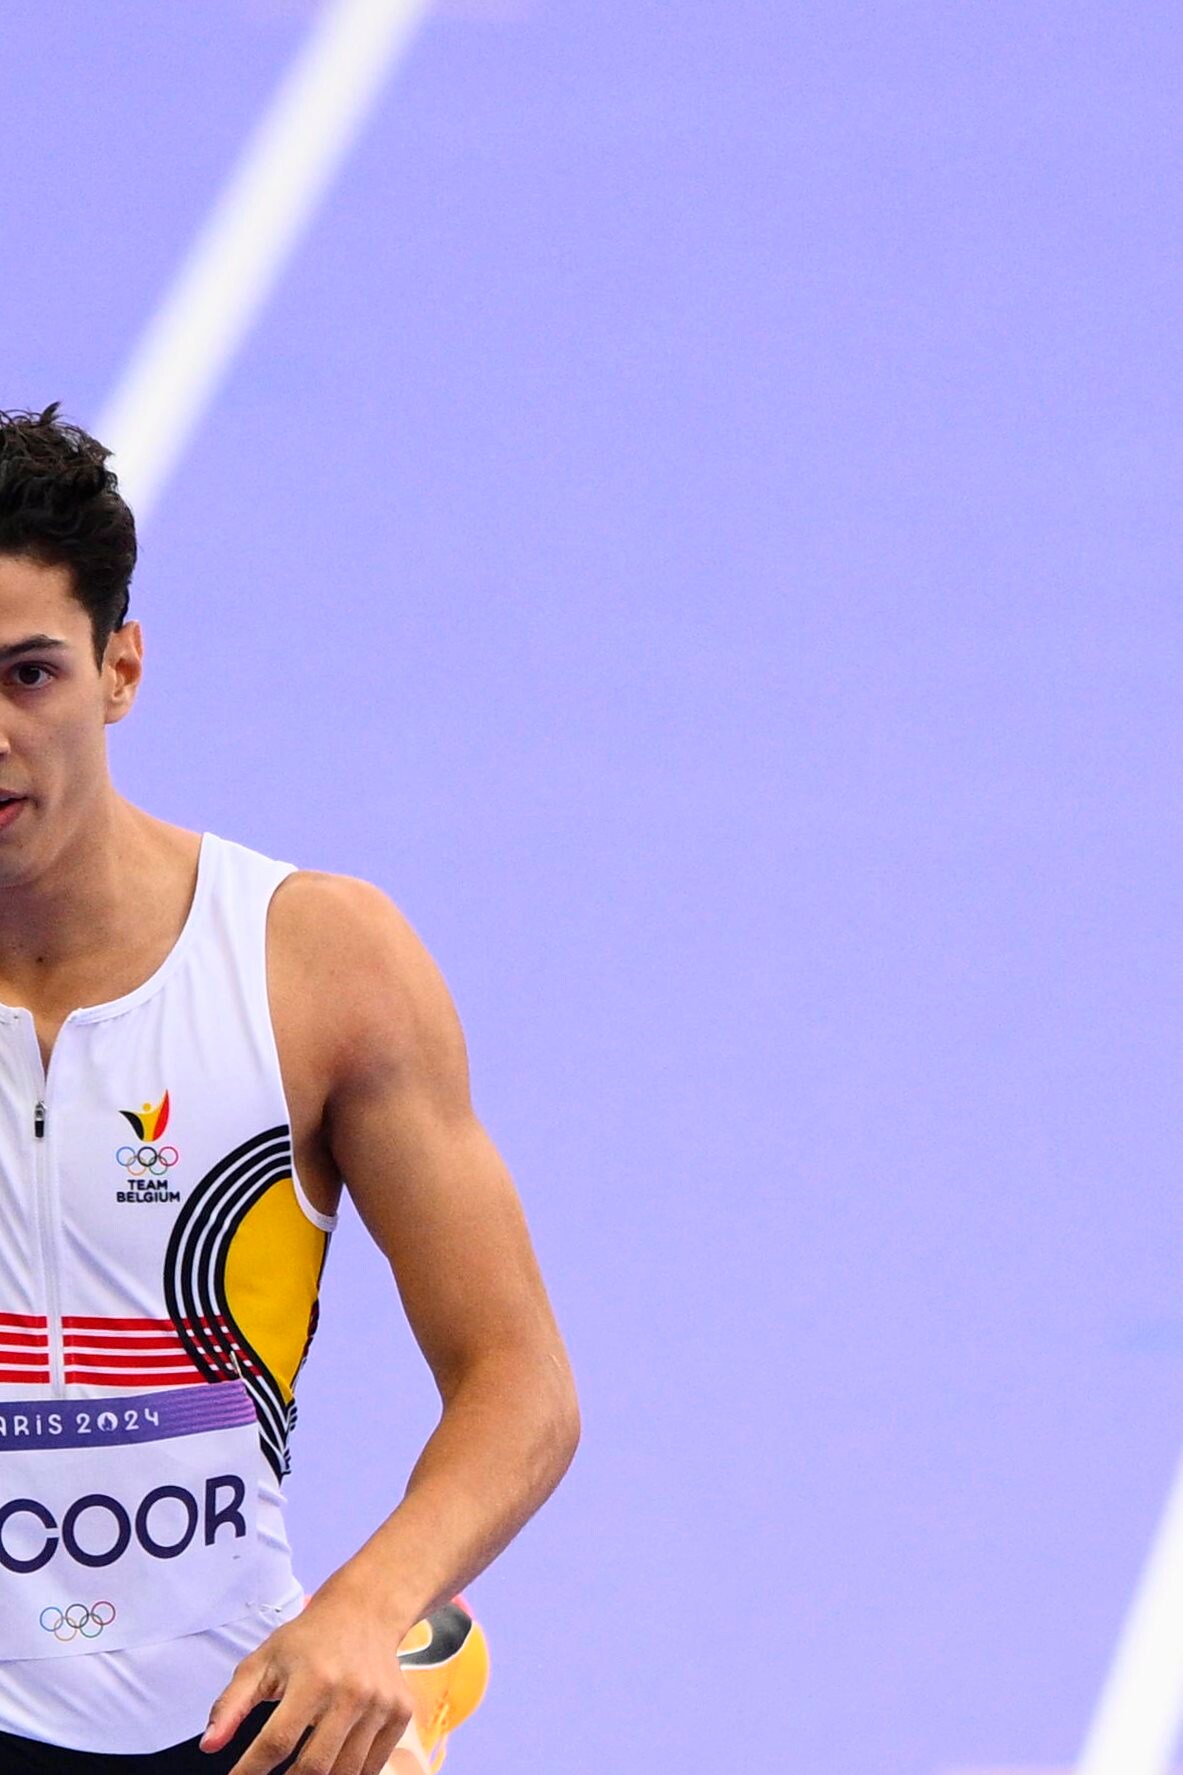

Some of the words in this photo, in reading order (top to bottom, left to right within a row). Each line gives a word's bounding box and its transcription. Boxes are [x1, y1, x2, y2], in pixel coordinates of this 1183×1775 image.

[127, 1179, 168, 1191] TEAM
[116, 1191, 181, 1203] BELGIUM
[76, 1407, 160, 1435] 2024
